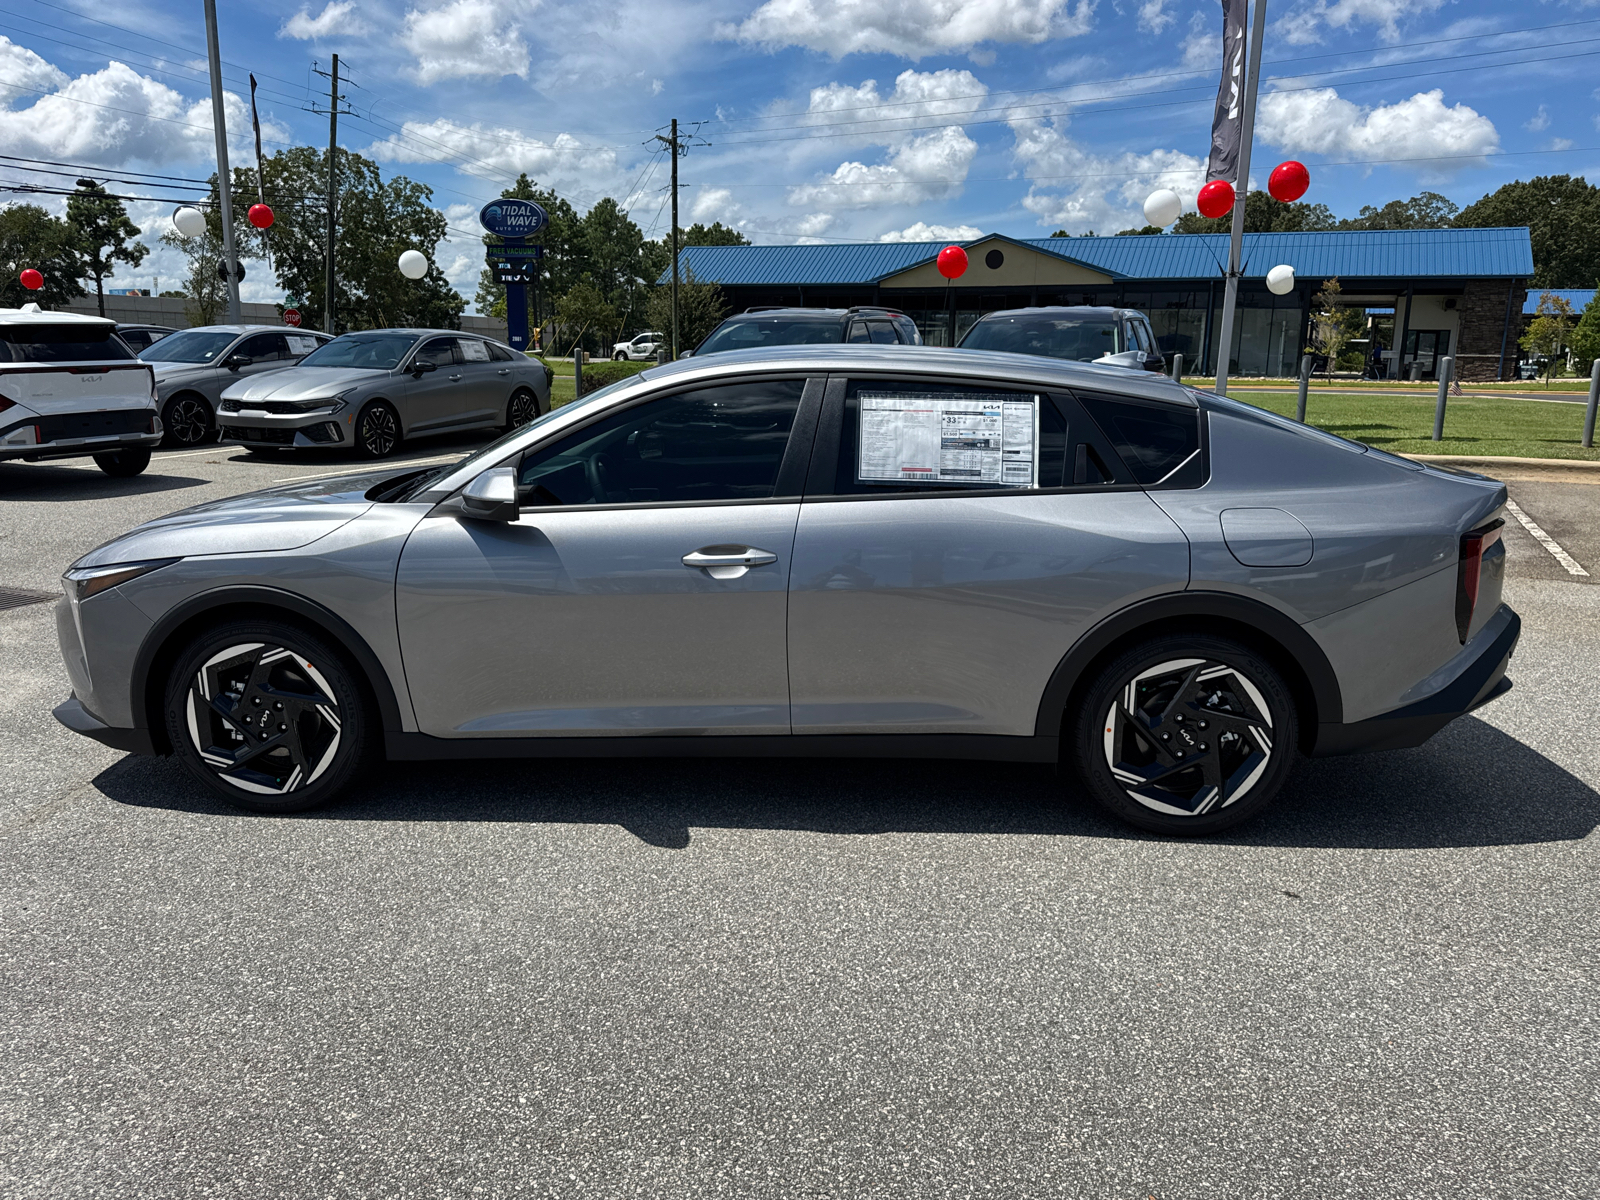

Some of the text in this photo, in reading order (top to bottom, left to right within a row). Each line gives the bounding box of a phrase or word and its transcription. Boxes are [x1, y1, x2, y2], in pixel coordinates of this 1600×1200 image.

[502, 205, 532, 216] TIDAL
[507, 216, 538, 226] WAVE
[489, 247, 536, 255] FREE VACUUMS
[285, 314, 300, 322] STOP
[81, 375, 103, 383] KIA
[946, 416, 957, 424] 33
[1246, 659, 1281, 697] SOLUS
[335, 675, 355, 720] SOLUS
[169, 710, 188, 757] KUMHO
[1094, 770, 1128, 811] KUMHO
